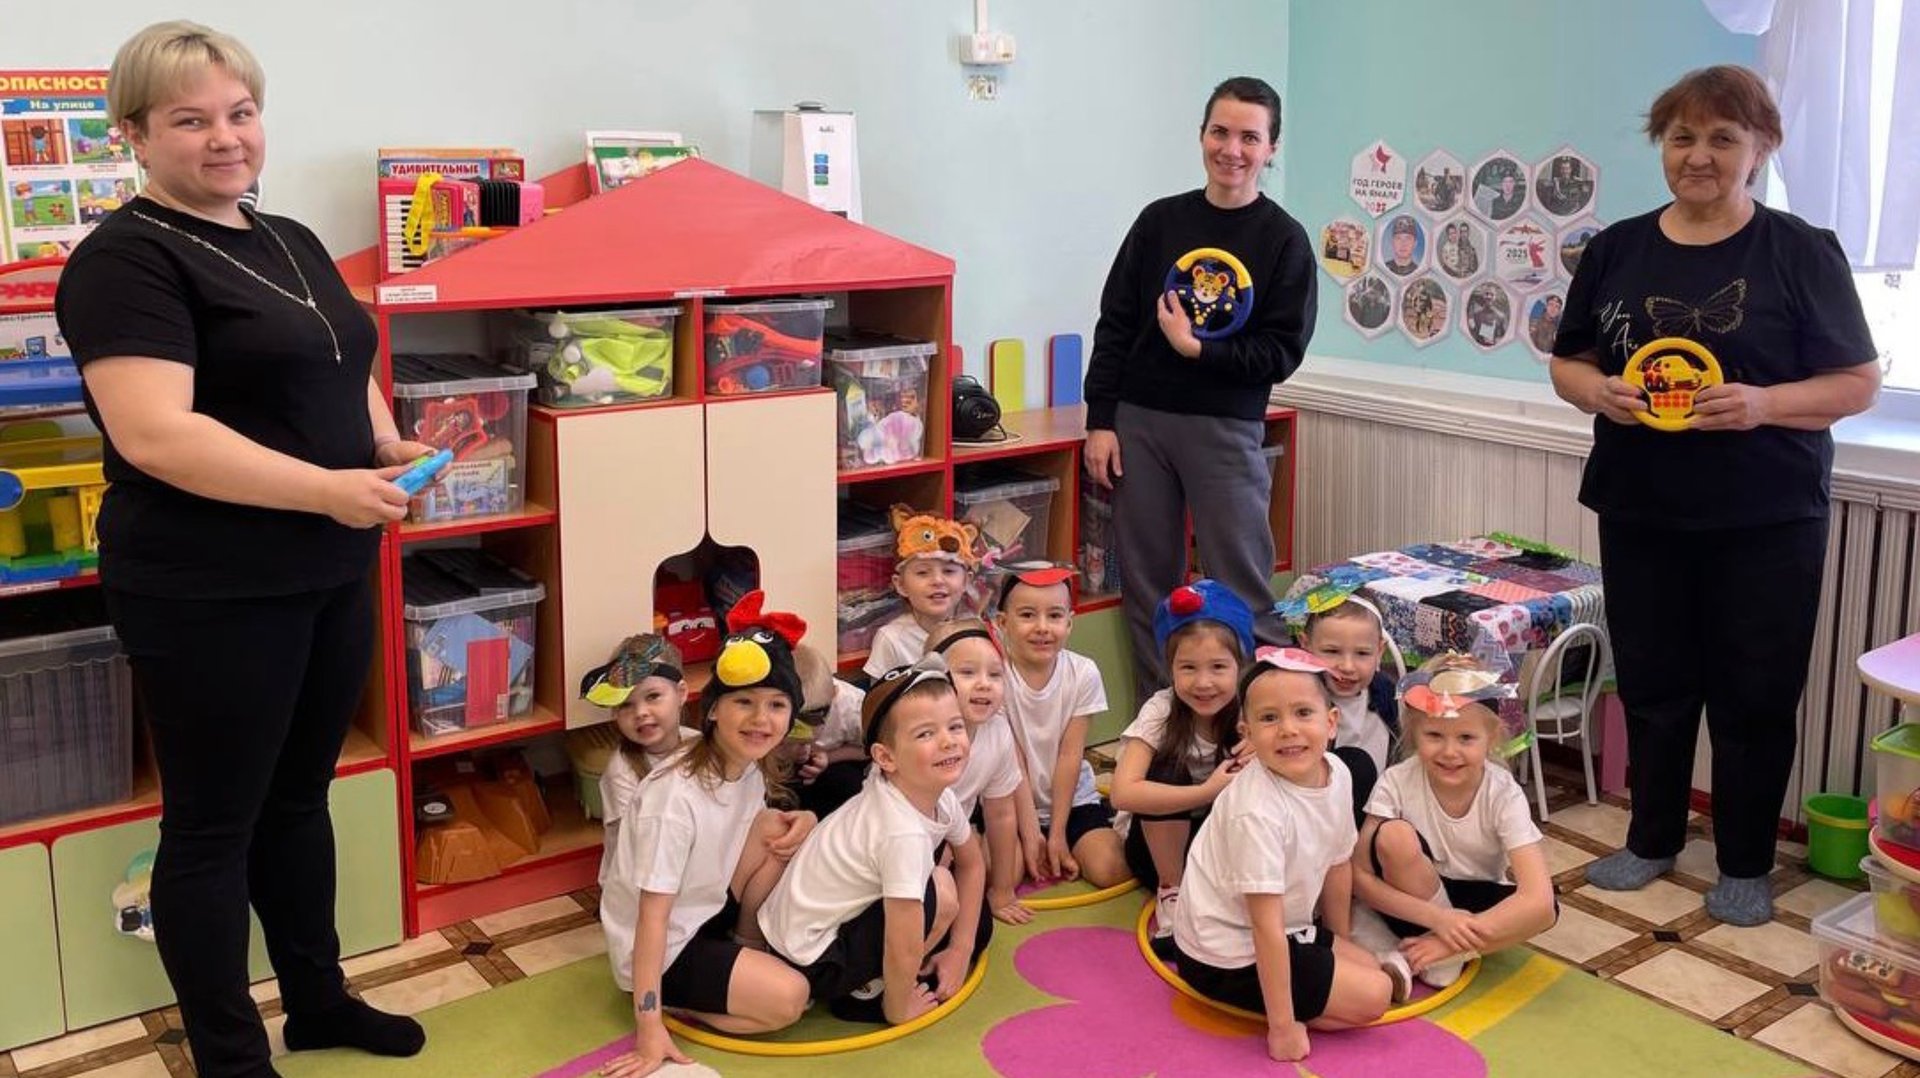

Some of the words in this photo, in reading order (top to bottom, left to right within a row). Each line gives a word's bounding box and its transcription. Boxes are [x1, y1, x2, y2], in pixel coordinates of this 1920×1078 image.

[29, 99, 50, 110] На
[53, 100, 95, 111] улице
[390, 161, 480, 176] УДИВИТЕЛЬНЫЕ
[1352, 178, 1369, 189] ГОД
[1370, 179, 1403, 191] ГЕРОЕВ
[1354, 188, 1367, 198] НА
[1369, 189, 1398, 200] ЯМАЛЕ
